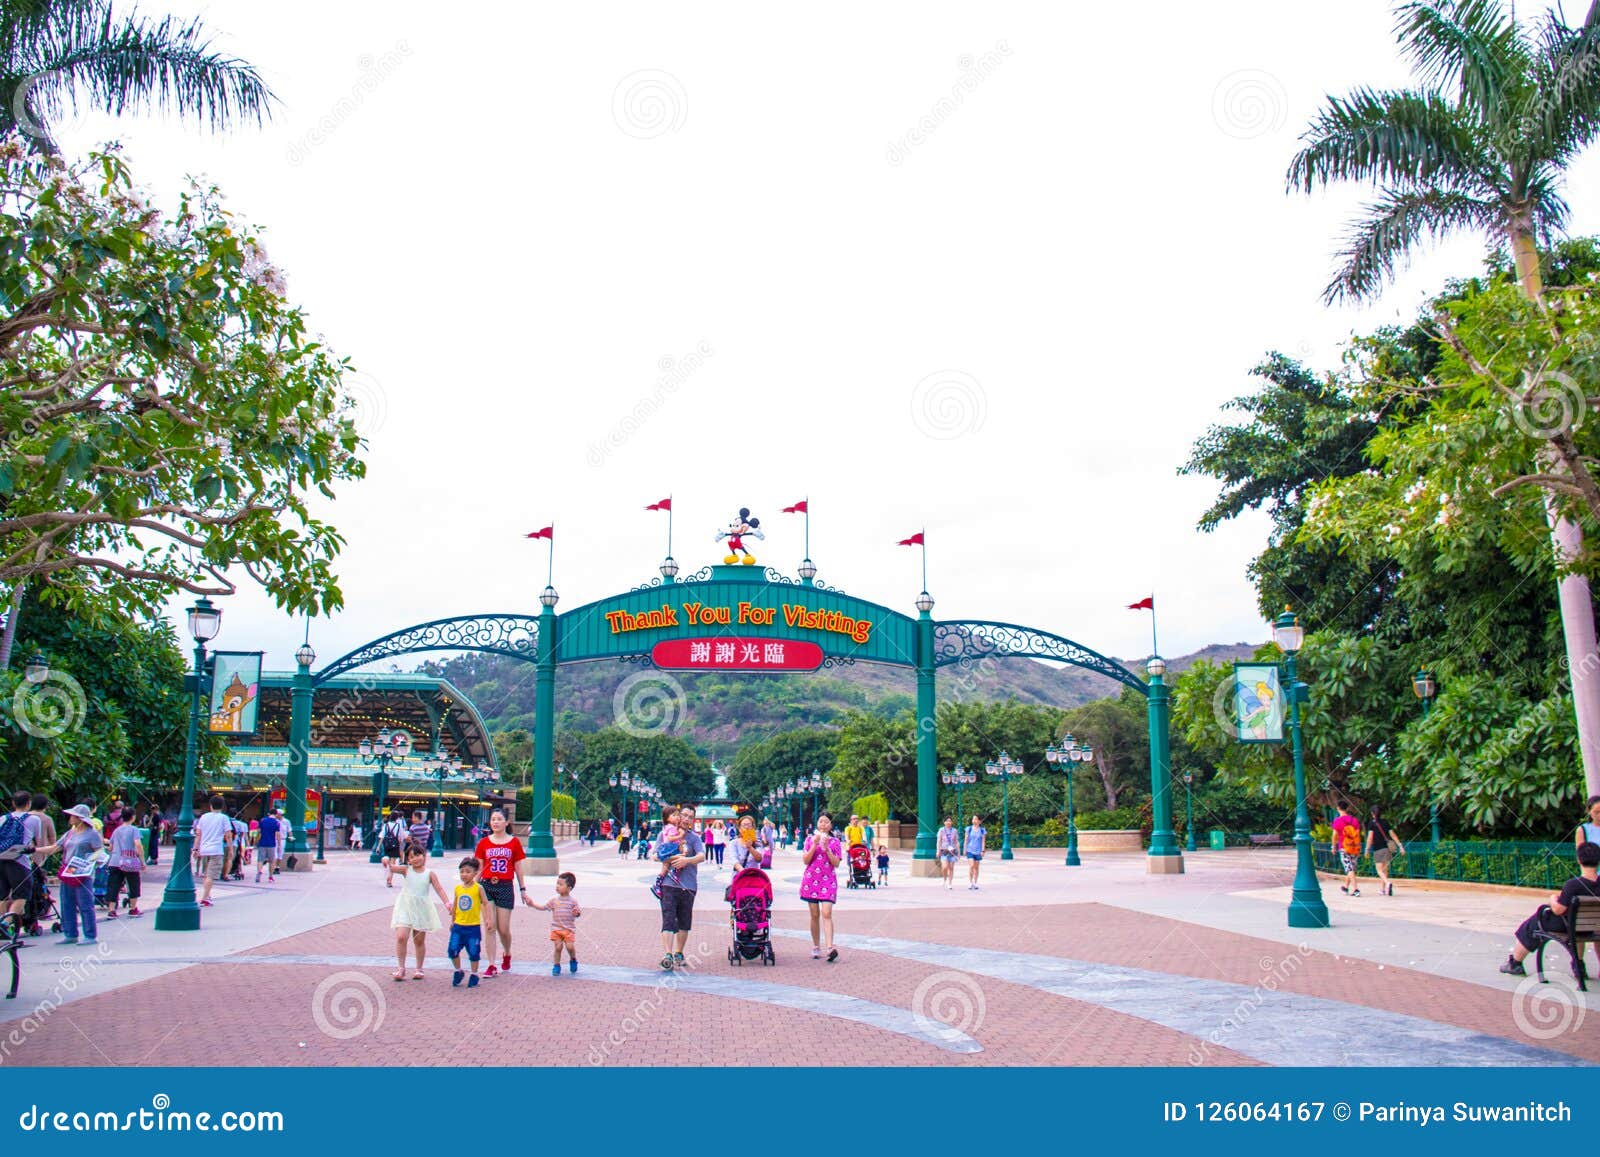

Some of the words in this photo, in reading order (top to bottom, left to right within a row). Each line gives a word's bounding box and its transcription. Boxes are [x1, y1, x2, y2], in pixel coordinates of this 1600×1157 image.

[606, 604, 678, 633] Thank
[684, 602, 731, 624] You
[738, 602, 775, 625] For
[783, 604, 871, 643] Visiting
[691, 641, 785, 664] 謝謝光臨
[490, 859, 507, 873] 32
